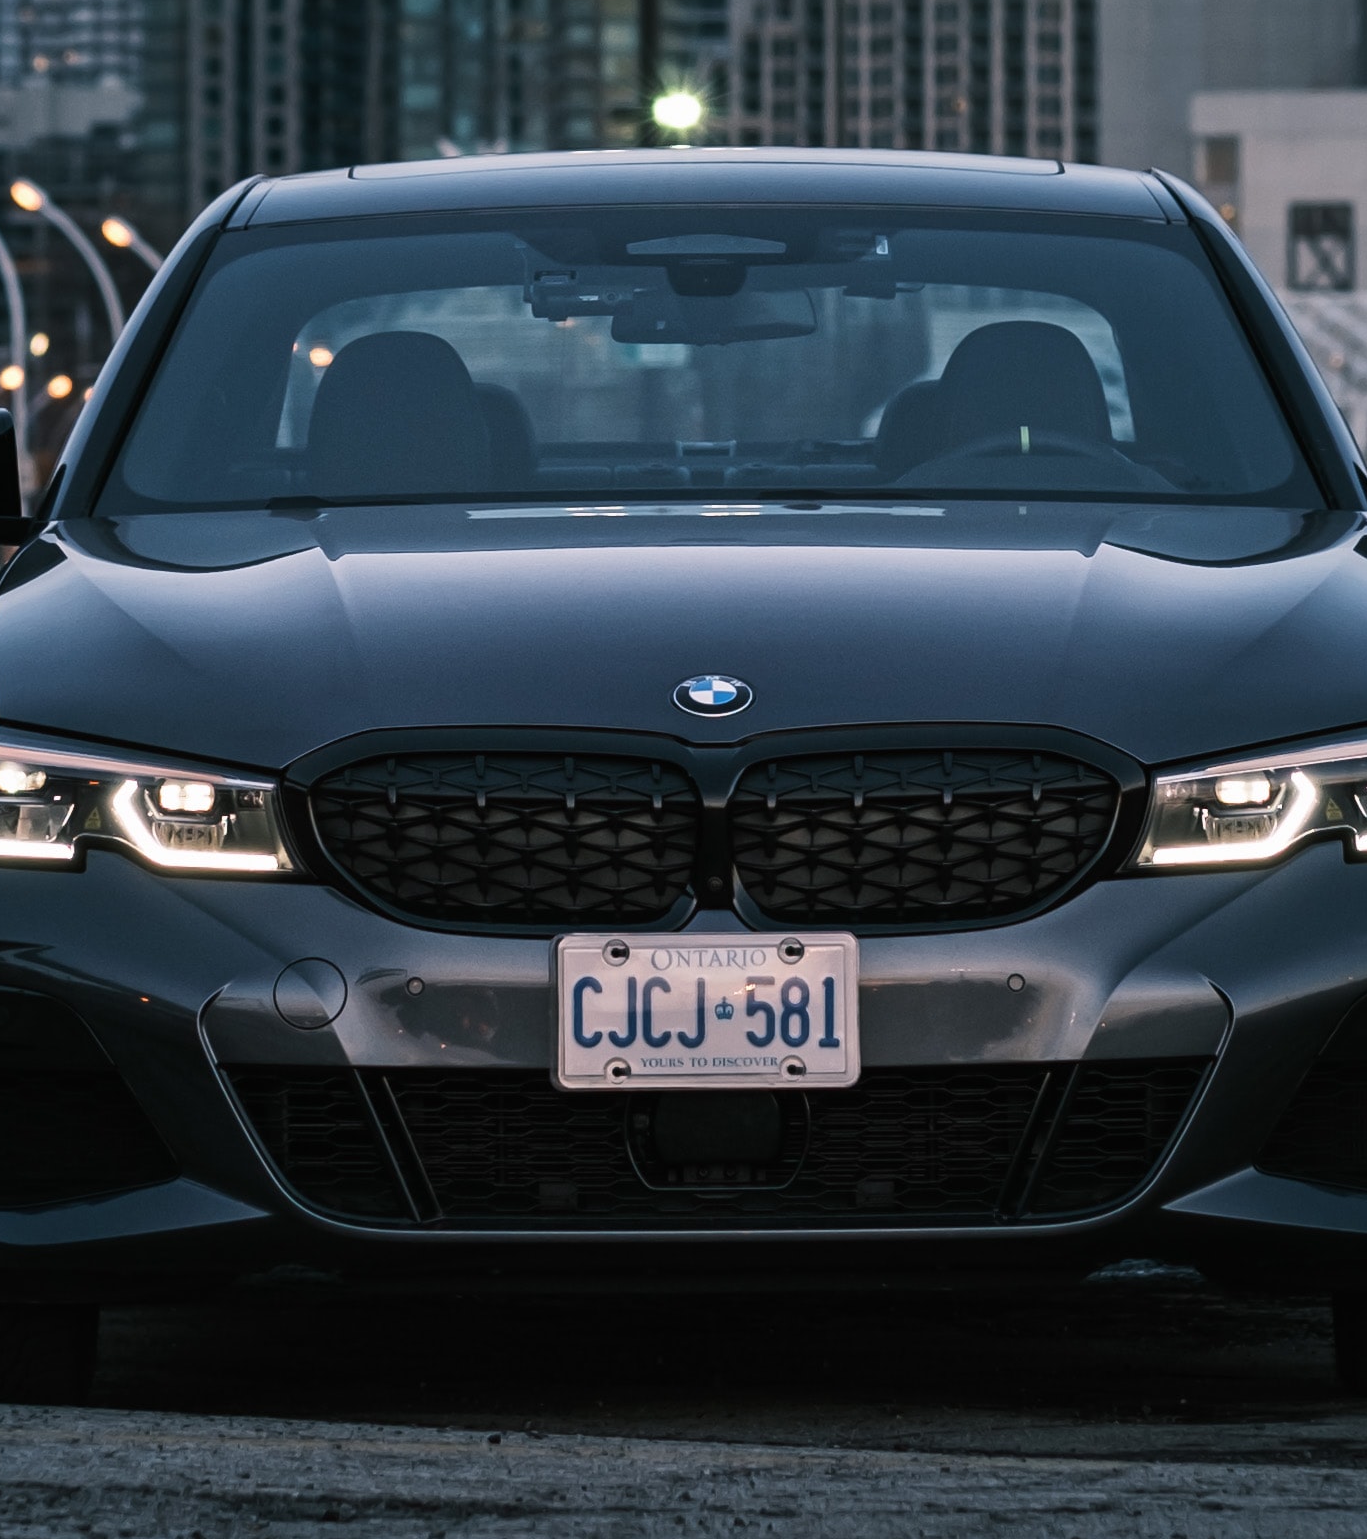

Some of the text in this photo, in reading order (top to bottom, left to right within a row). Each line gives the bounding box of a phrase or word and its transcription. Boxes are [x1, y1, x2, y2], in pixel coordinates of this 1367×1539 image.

[573, 976, 840, 1049] CJCJ 581
[640, 1056, 779, 1068] YOURS TO DISCOVER
